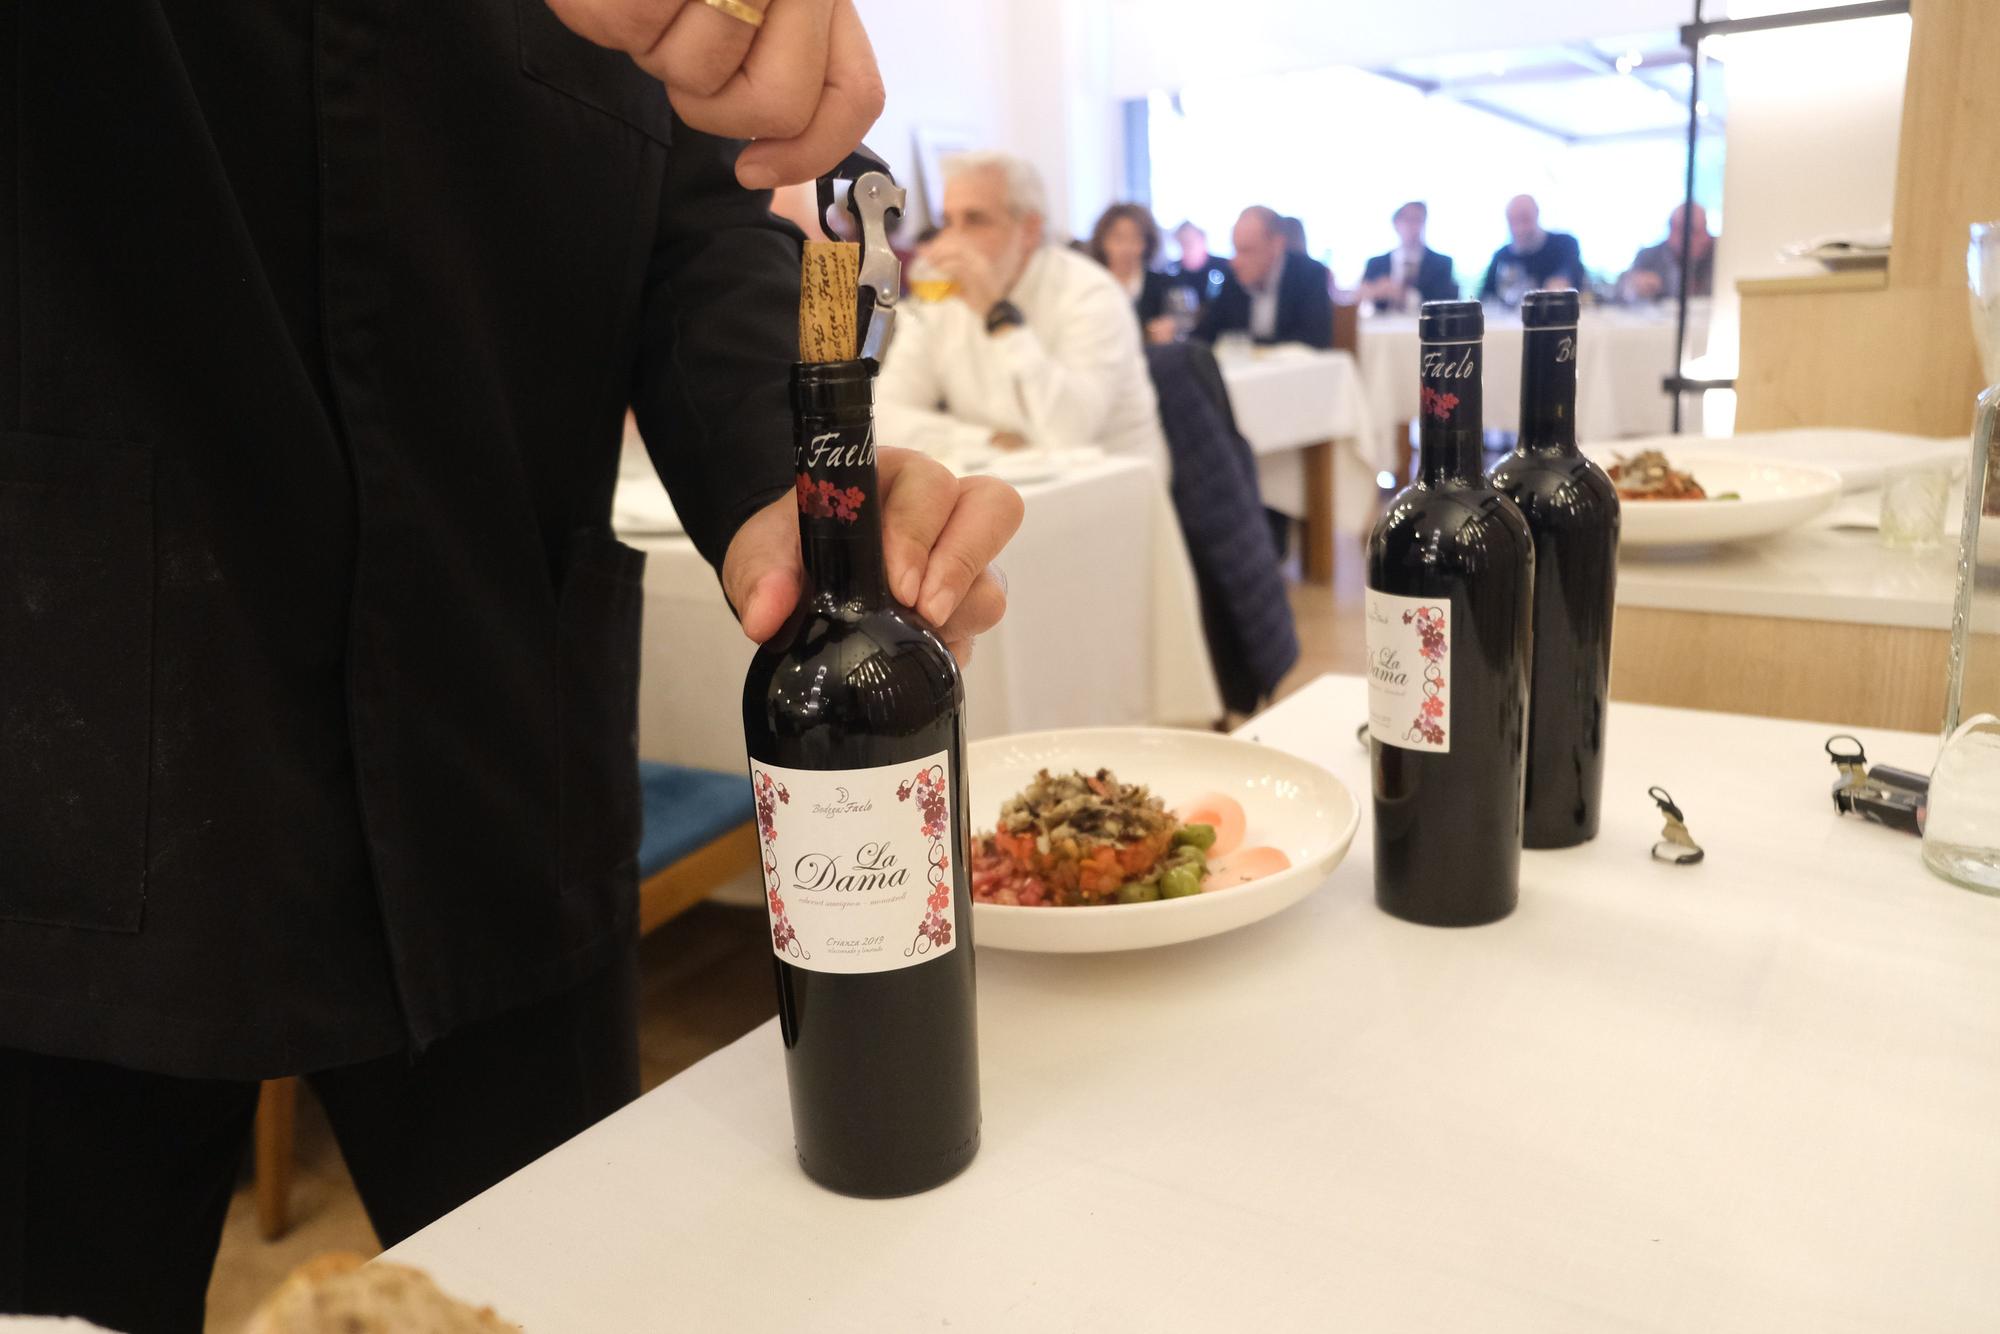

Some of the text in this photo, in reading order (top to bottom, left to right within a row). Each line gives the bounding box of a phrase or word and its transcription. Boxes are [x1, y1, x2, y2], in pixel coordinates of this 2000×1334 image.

[1422, 347, 1474, 379] Faelo
[807, 423, 876, 468] Faelo
[1379, 647, 1401, 670] La
[844, 799, 873, 814] Faelo
[853, 841, 898, 871] La
[792, 853, 911, 893] Dama
[825, 935, 885, 947] Crianza 2019
